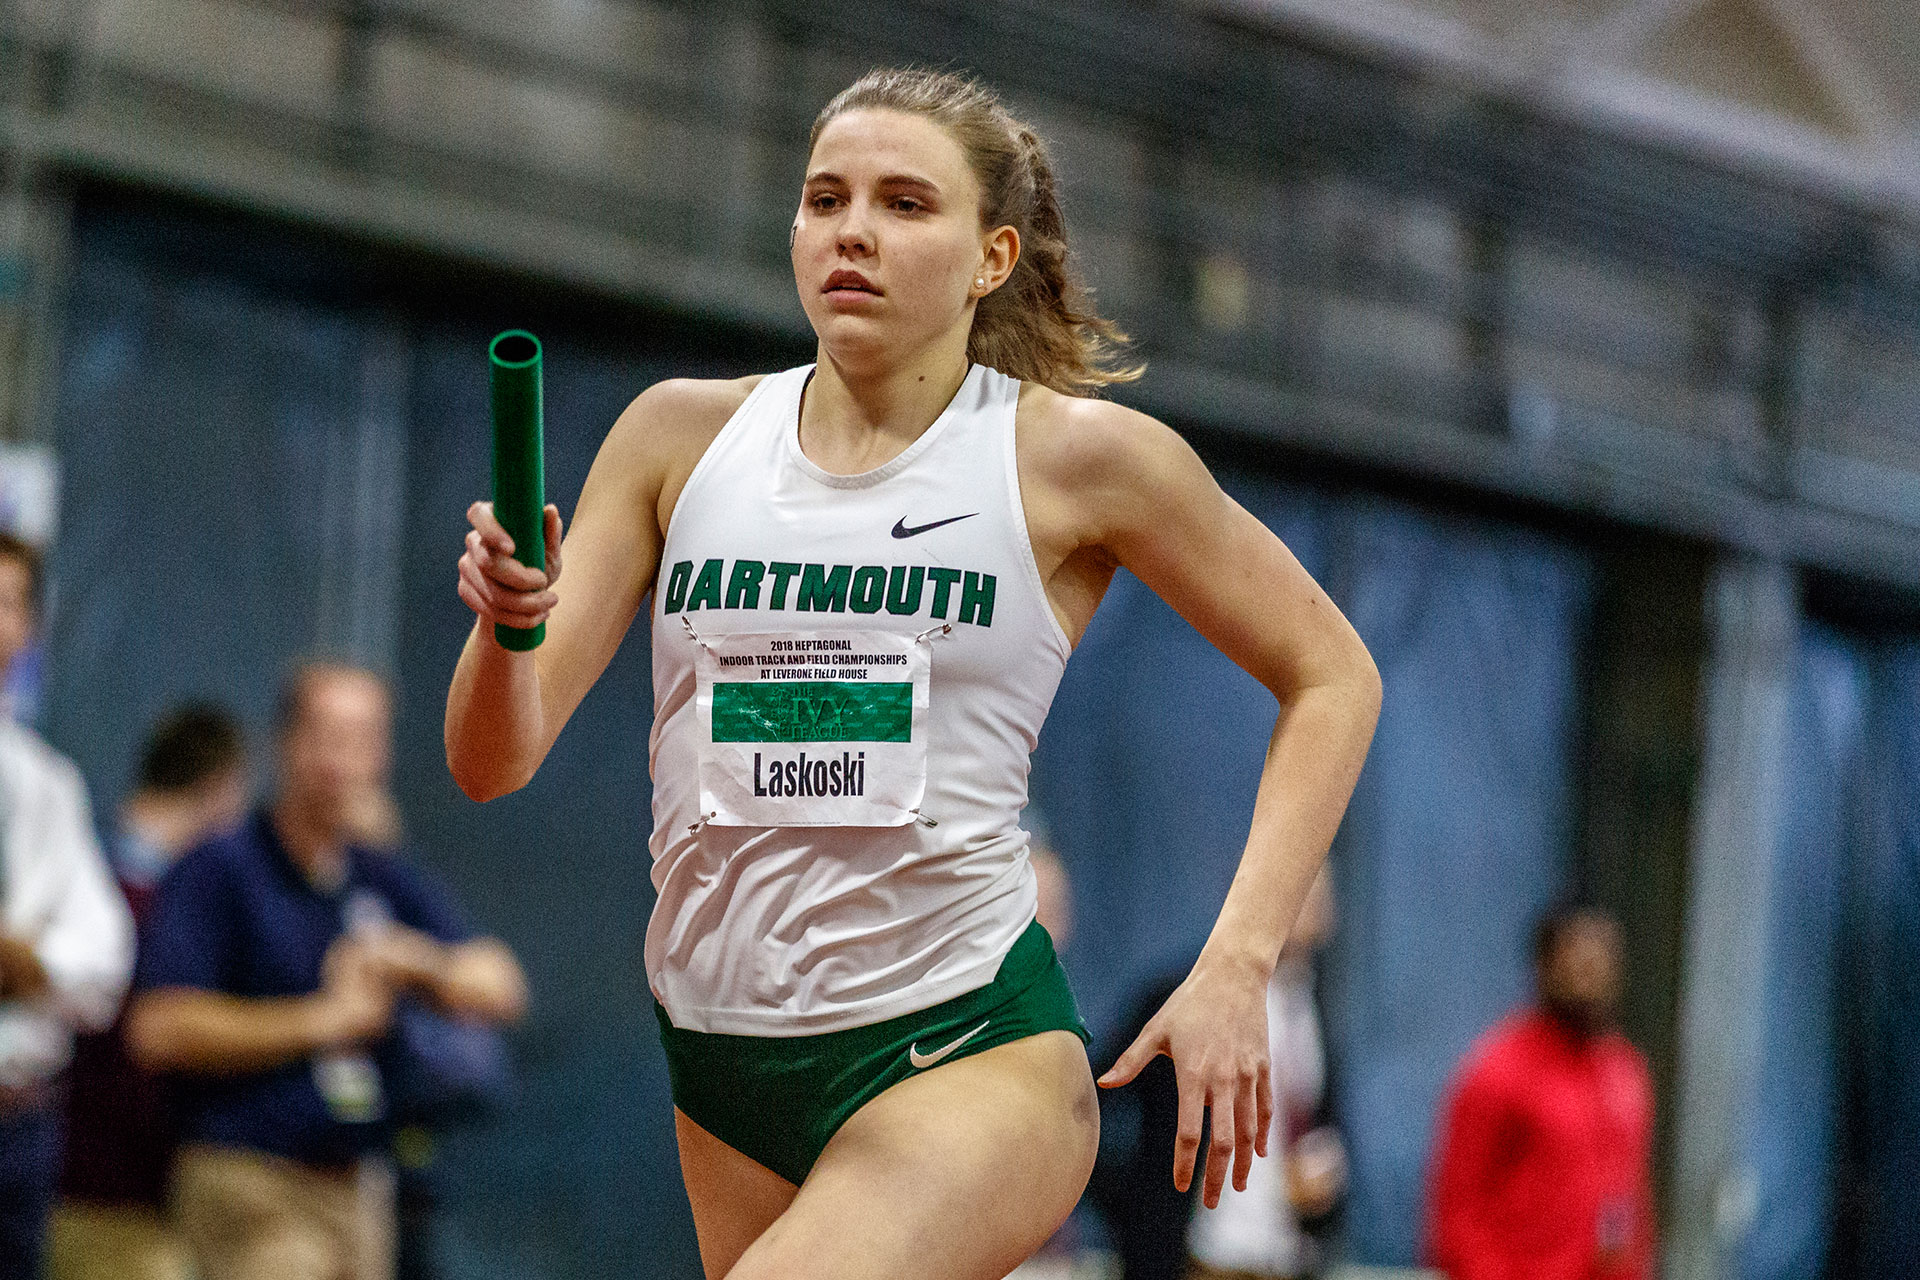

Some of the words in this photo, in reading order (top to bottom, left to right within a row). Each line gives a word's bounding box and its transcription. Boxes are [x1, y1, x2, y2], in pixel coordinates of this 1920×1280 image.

[664, 558, 997, 628] DARTMOUTH
[770, 640, 793, 651] 2018
[795, 640, 852, 651] HEPTAGONAL
[720, 655, 754, 666] INDOOR
[755, 655, 786, 666] TRACK
[787, 654, 806, 665] AND
[807, 654, 830, 665] FIELD
[832, 654, 908, 666] CHAMPIONSHIPS
[760, 669, 771, 679] AT
[773, 669, 812, 679] LEVERONE
[814, 669, 837, 679] FIELD
[838, 669, 868, 679] HOUSE
[792, 697, 849, 724] IVY
[791, 725, 848, 739] LEAGUE
[754, 751, 865, 797] Laskoski
